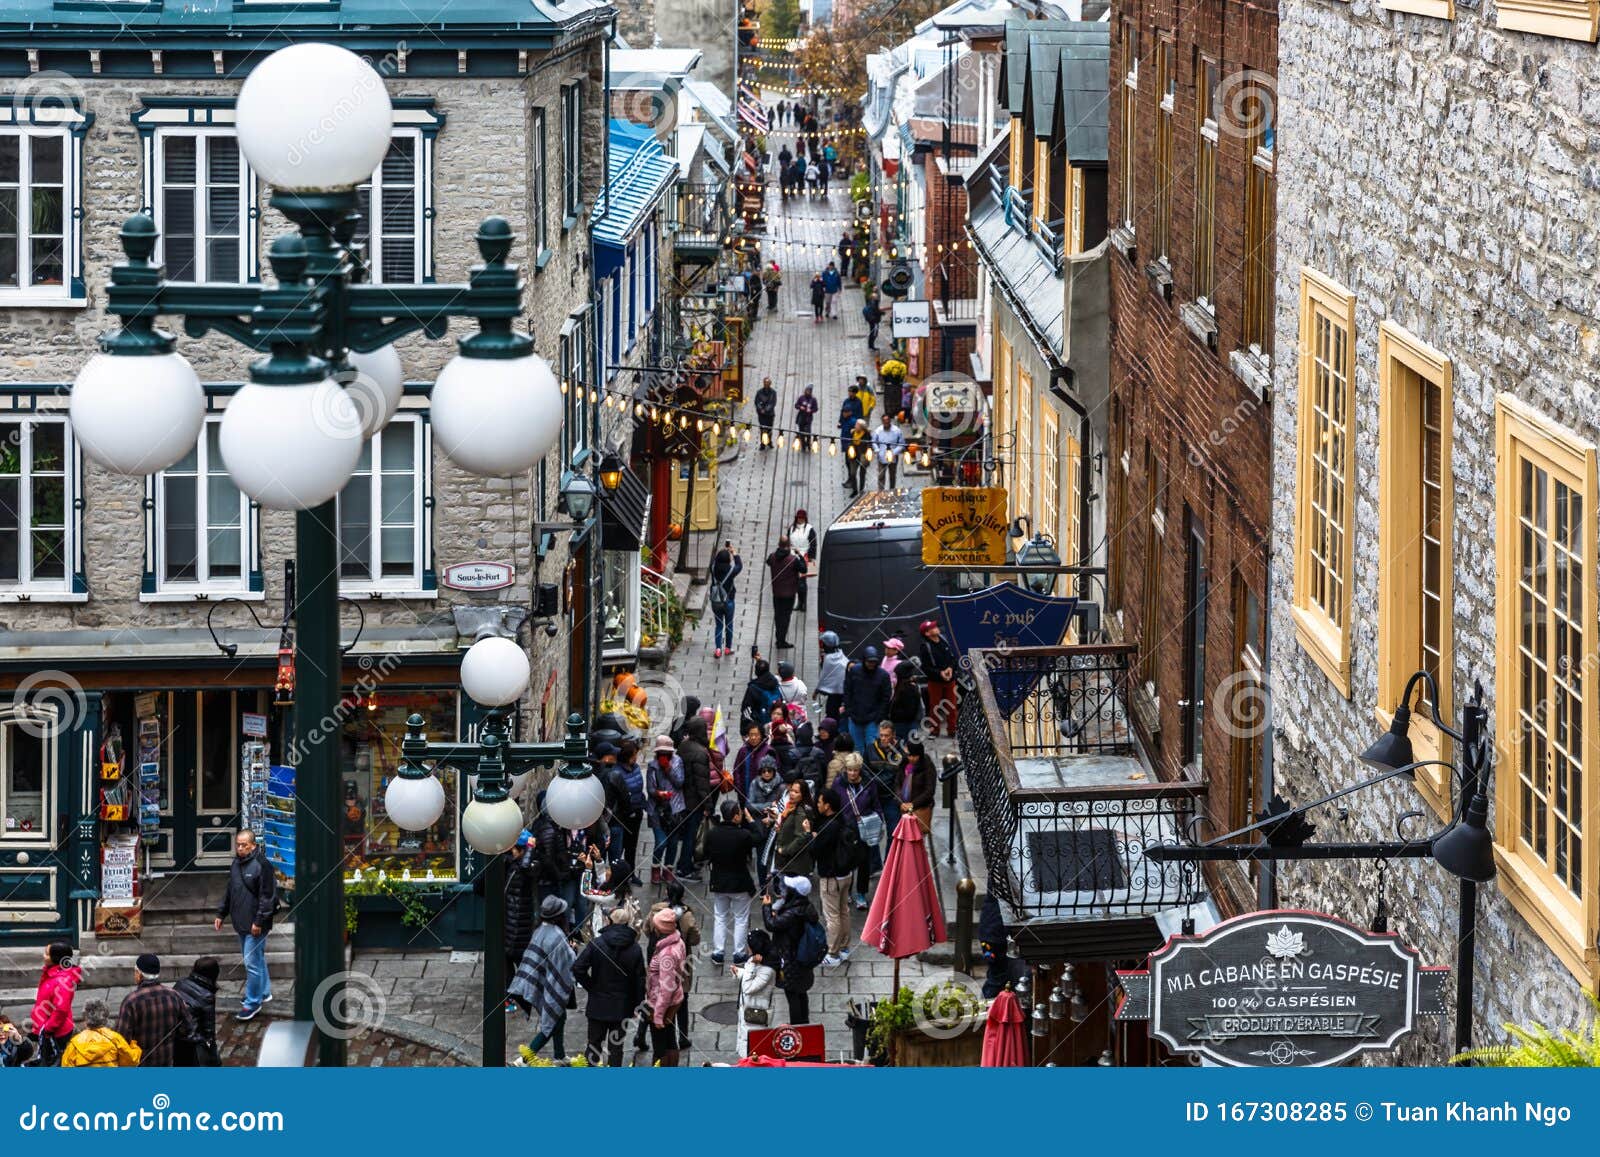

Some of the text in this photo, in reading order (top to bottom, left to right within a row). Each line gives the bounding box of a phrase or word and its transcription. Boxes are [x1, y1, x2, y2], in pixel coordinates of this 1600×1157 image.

[942, 491, 987, 504] boutique
[925, 511, 964, 532] Louis
[938, 552, 990, 562] souvenirs
[457, 573, 500, 581] Sous-le-Fort
[980, 608, 1035, 627] Le pub
[1167, 961, 1402, 994] MA CABANE EN GASPÉSIE
[1212, 997, 1237, 1008] 100
[1265, 993, 1356, 1008] GASPÉSIEN
[1223, 1017, 1280, 1032] PRODUIT
